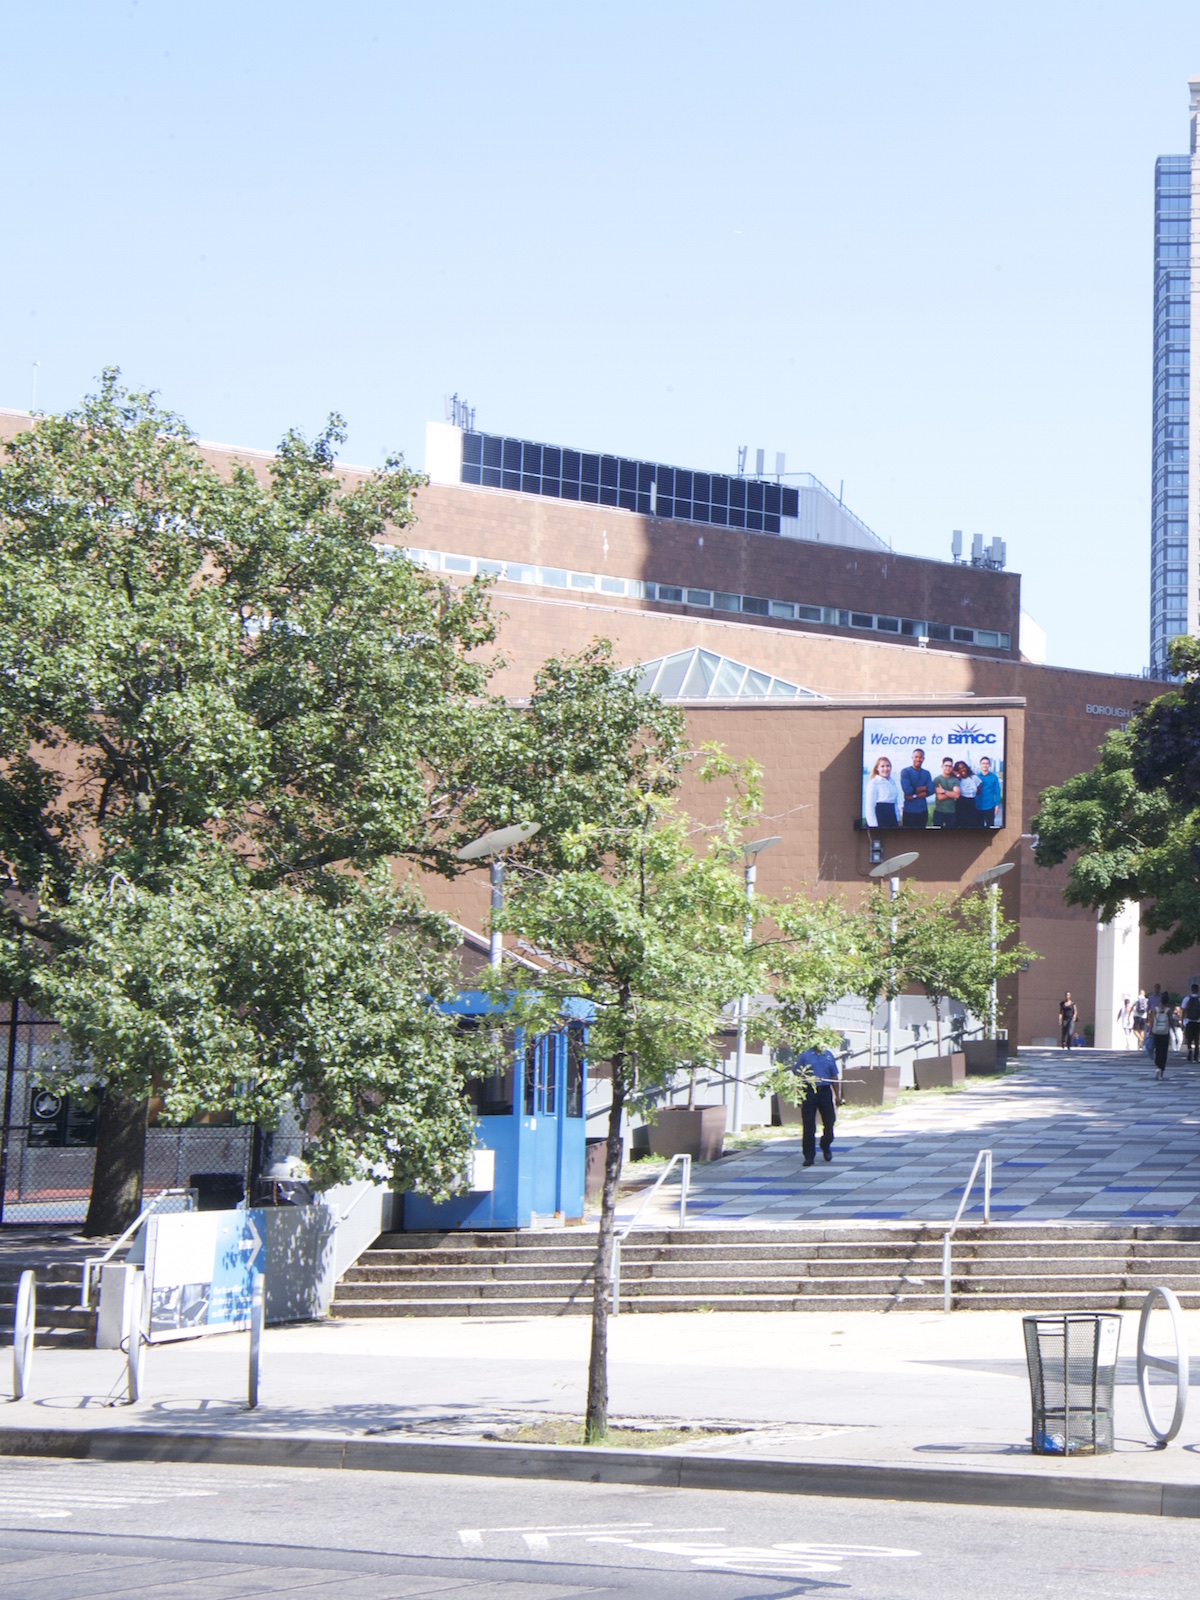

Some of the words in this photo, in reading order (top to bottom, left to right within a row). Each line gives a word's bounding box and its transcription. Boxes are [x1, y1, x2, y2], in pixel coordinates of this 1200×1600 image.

[1085, 703, 1130, 718] BOROUGH
[870, 733, 926, 745] Welcome
[931, 733, 943, 745] to
